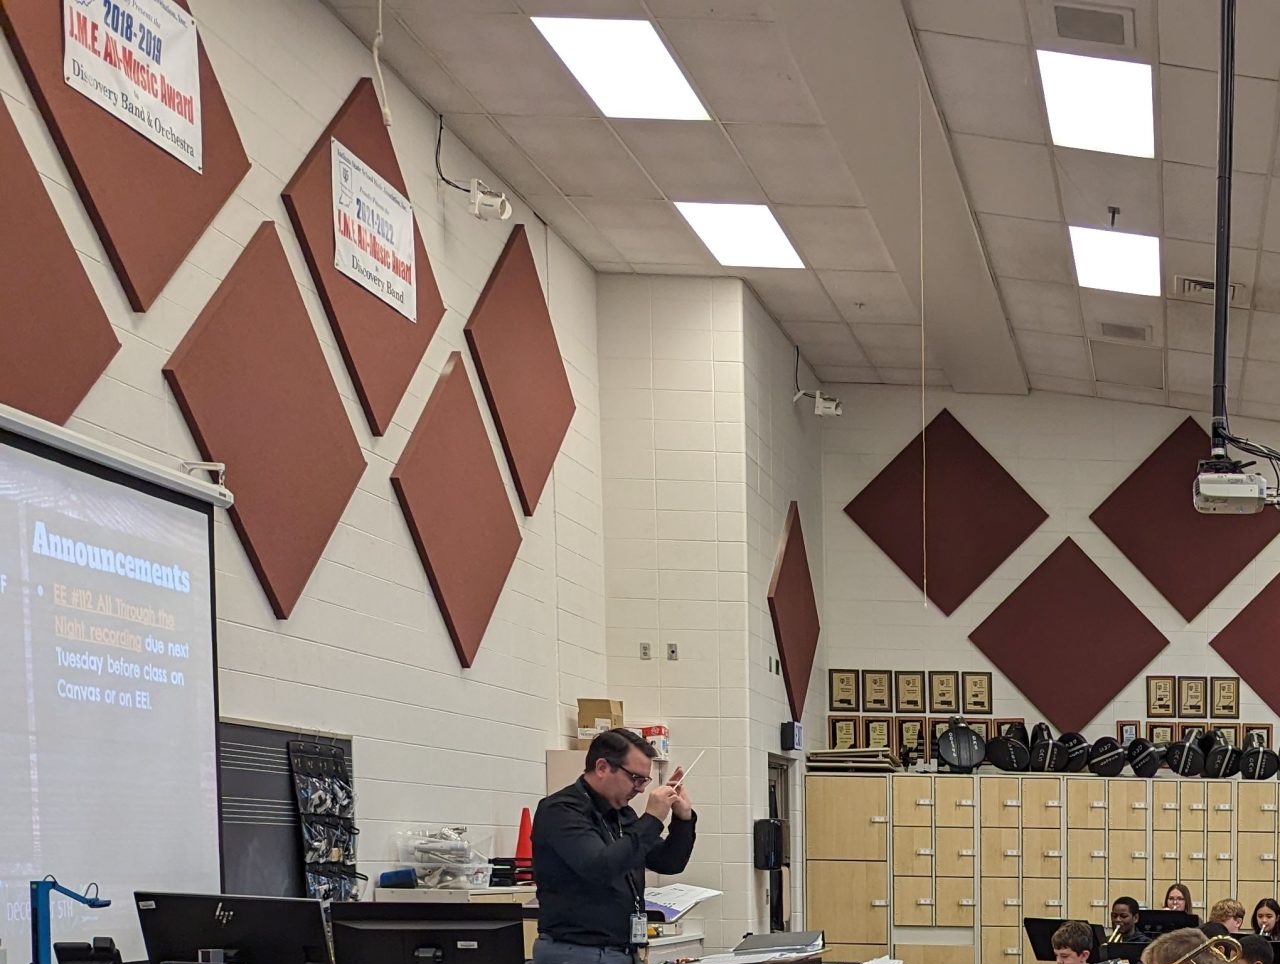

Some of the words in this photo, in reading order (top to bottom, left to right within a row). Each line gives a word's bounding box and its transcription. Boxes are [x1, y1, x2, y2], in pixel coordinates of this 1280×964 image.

[103, 0, 163, 66] 2018-2019
[69, 6, 101, 58] J.M.E.
[103, 31, 158, 100] All-Music
[160, 73, 195, 125] Award
[72, 58, 119, 107] Discovery
[120, 91, 146, 123] Band
[146, 110, 153, 128] &
[154, 117, 195, 158] Orchestra
[351, 254, 386, 292] Discovery
[386, 281, 405, 304] Band
[391, 250, 412, 286] Award
[32, 520, 191, 594] Announcements
[53, 583, 67, 604] EE
[71, 588, 93, 608] #112
[97, 594, 113, 614] All
[115, 596, 156, 624] Through
[158, 610, 176, 628] the
[55, 615, 85, 640] Night
[90, 624, 142, 651] recording
[144, 634, 165, 655] due
[167, 641, 190, 660] next
[55, 646, 104, 676] Tuesday
[107, 654, 141, 679] before
[143, 663, 168, 683] class
[170, 670, 185, 687] on
[57, 678, 101, 703] Canvas
[104, 689, 115, 705] or
[119, 691, 133, 708] on
